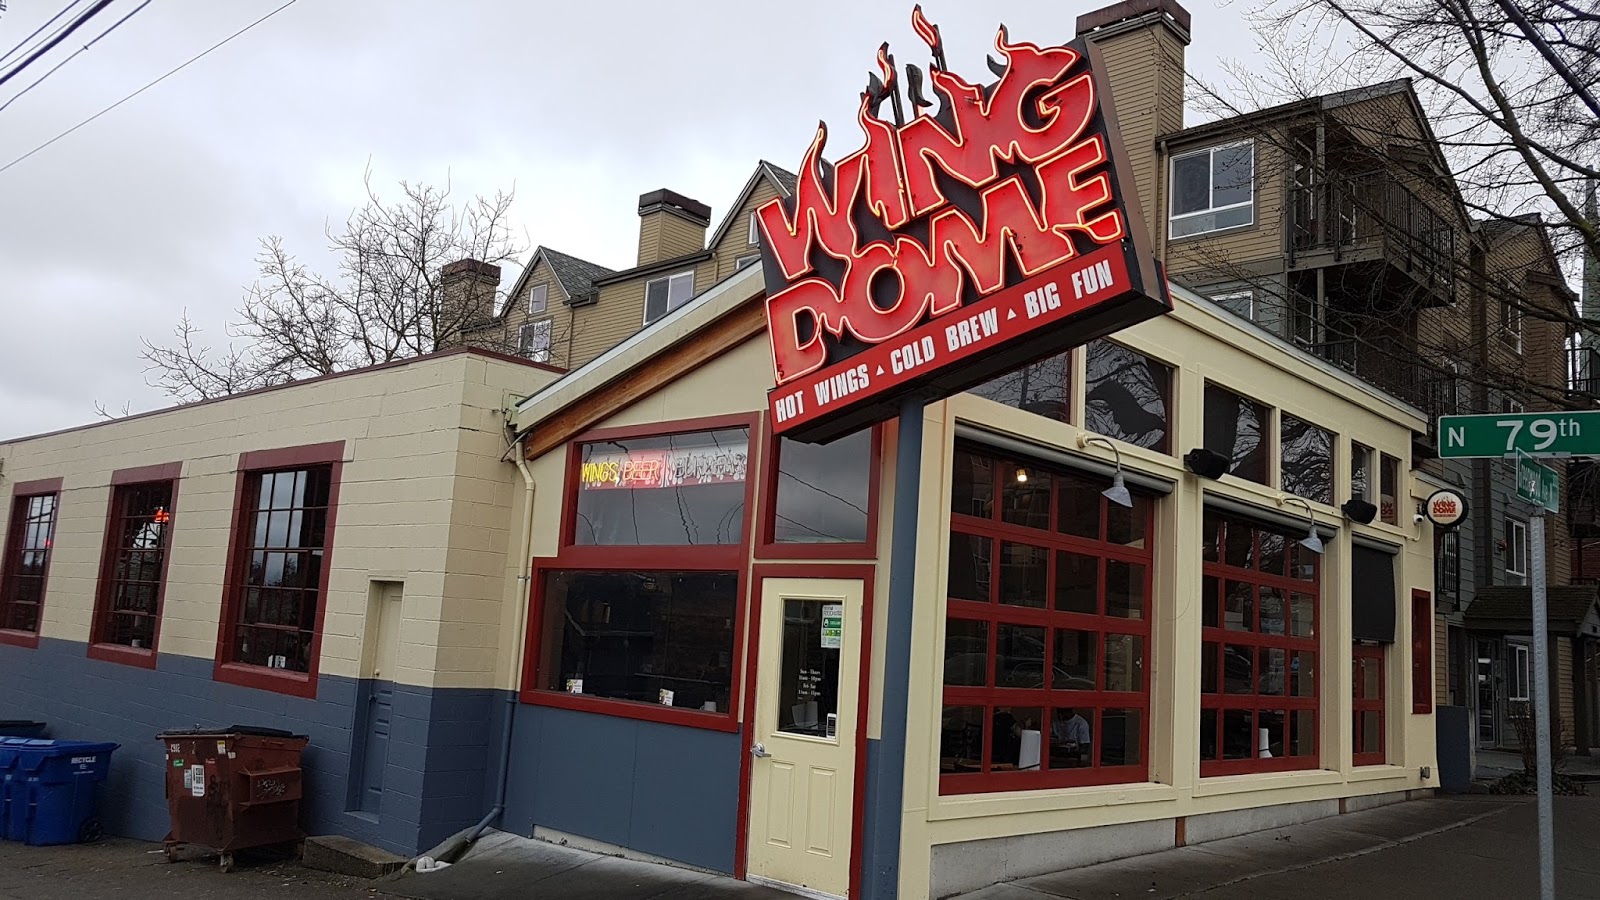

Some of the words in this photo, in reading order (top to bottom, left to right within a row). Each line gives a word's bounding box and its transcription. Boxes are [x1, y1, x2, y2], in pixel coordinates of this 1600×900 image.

[756, 22, 1097, 281] WING
[765, 134, 1126, 388] DOME
[775, 391, 804, 424] HOT
[814, 363, 870, 407] WINGS
[890, 335, 936, 375] COLD
[945, 307, 999, 352] BREW
[1024, 282, 1062, 319] BIG
[1071, 259, 1113, 299] FUN
[1448, 427, 1465, 447] N
[1496, 418, 1581, 451] 79th
[622, 459, 660, 482] BEER
[1433, 500, 1456, 508] WING
[71, 756, 96, 764] RECYCLE
